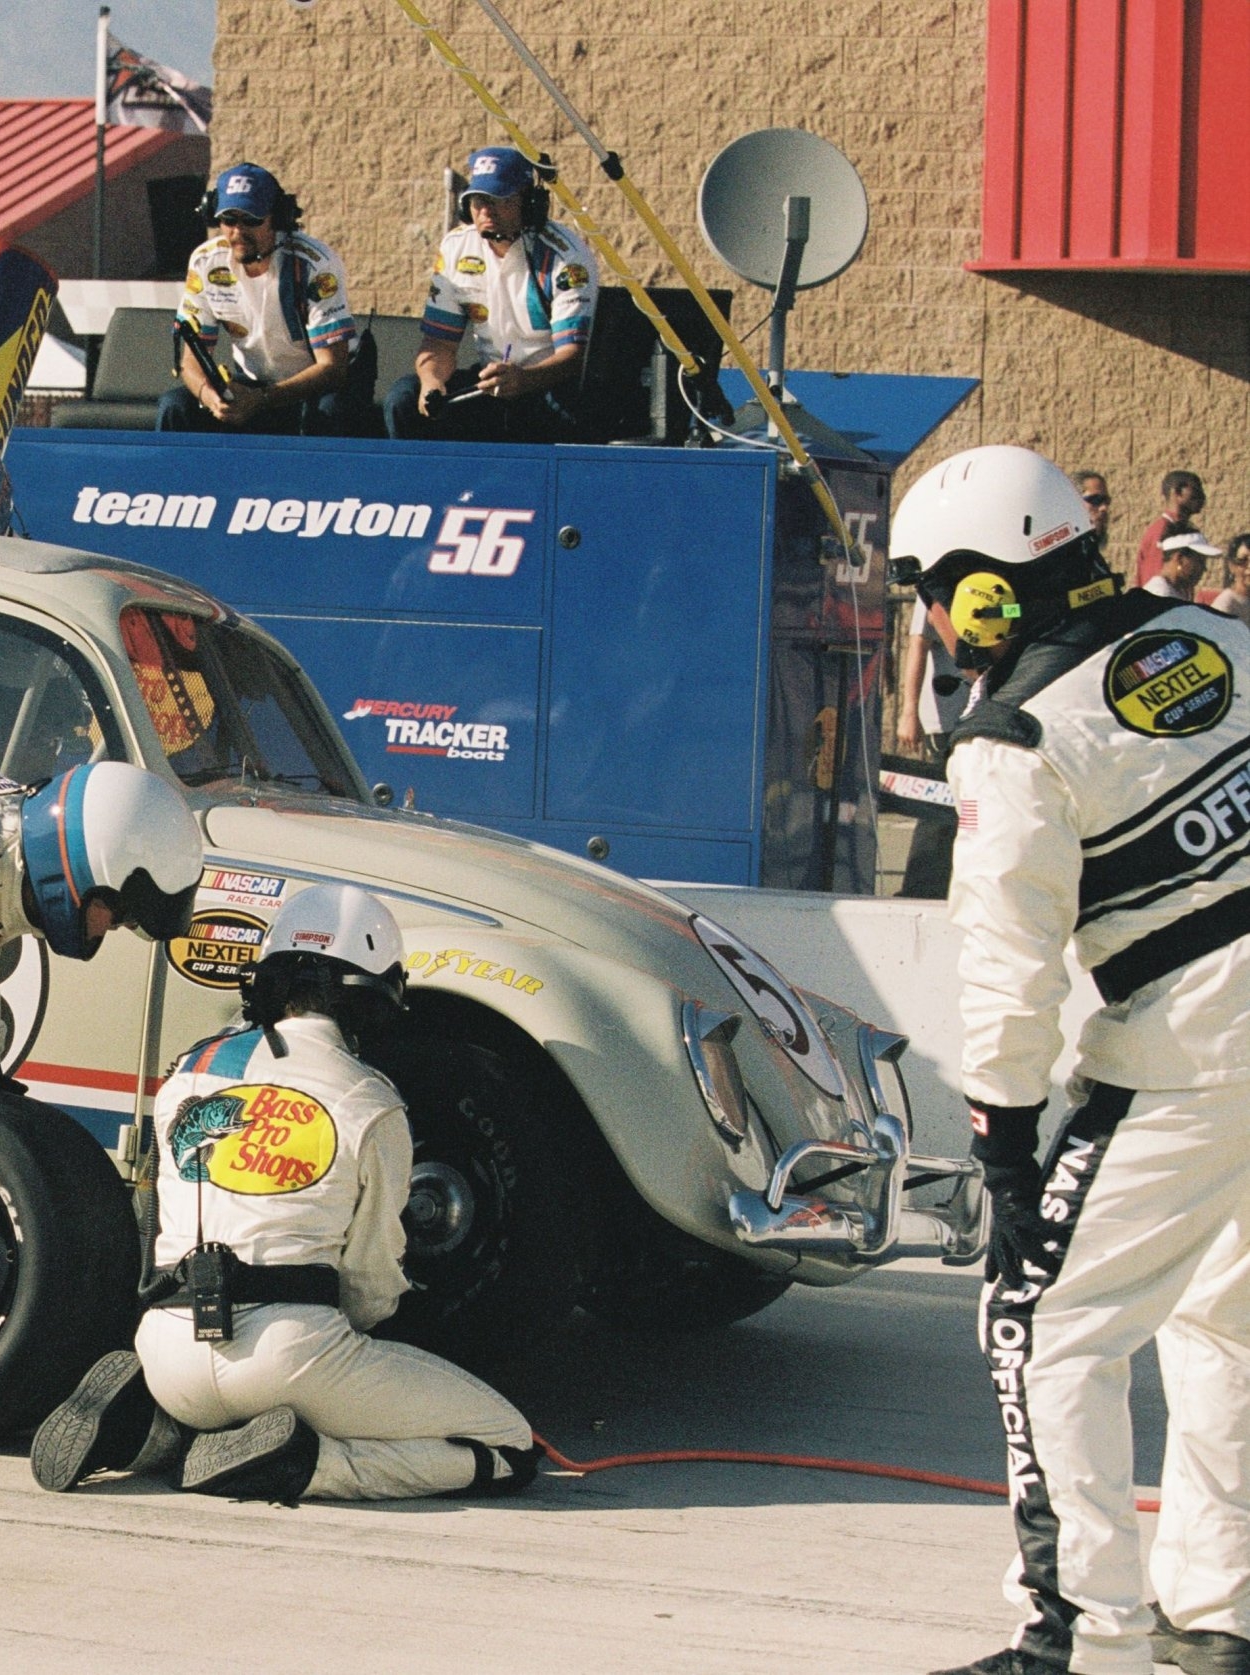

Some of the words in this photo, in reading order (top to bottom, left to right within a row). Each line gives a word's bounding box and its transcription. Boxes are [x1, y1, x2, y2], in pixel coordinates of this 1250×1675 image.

[473, 157, 499, 175] 56
[226, 176, 254, 195] 56
[73, 486, 217, 528] team
[227, 497, 432, 538] peyton
[428, 507, 536, 575] 56
[1033, 526, 1071, 551] SIMPSON
[1138, 640, 1190, 677] NASCAR
[1136, 662, 1211, 712] NEXTEL
[352, 698, 458, 720] MERCURY
[1163, 706, 1185, 724] CUP
[1184, 687, 1219, 712] SERIES
[385, 719, 508, 750] TRACKER
[446, 747, 505, 761] boats
[221, 873, 278, 895] NASCAR
[227, 894, 255, 905] RACE
[259, 898, 283, 908] CAR
[212, 926, 260, 944] NASCAR
[294, 933, 331, 944] SIMPSON
[187, 941, 255, 962] NEXTEL
[191, 962, 214, 971] CUP
[406, 949, 544, 995] DYEAR
[246, 1087, 319, 1125] Bass
[239, 1117, 291, 1146] Pro
[230, 1143, 317, 1187] Shops
[1002, 1135, 1095, 1303] NASR
[991, 1318, 1040, 1500] OFFICIAL
